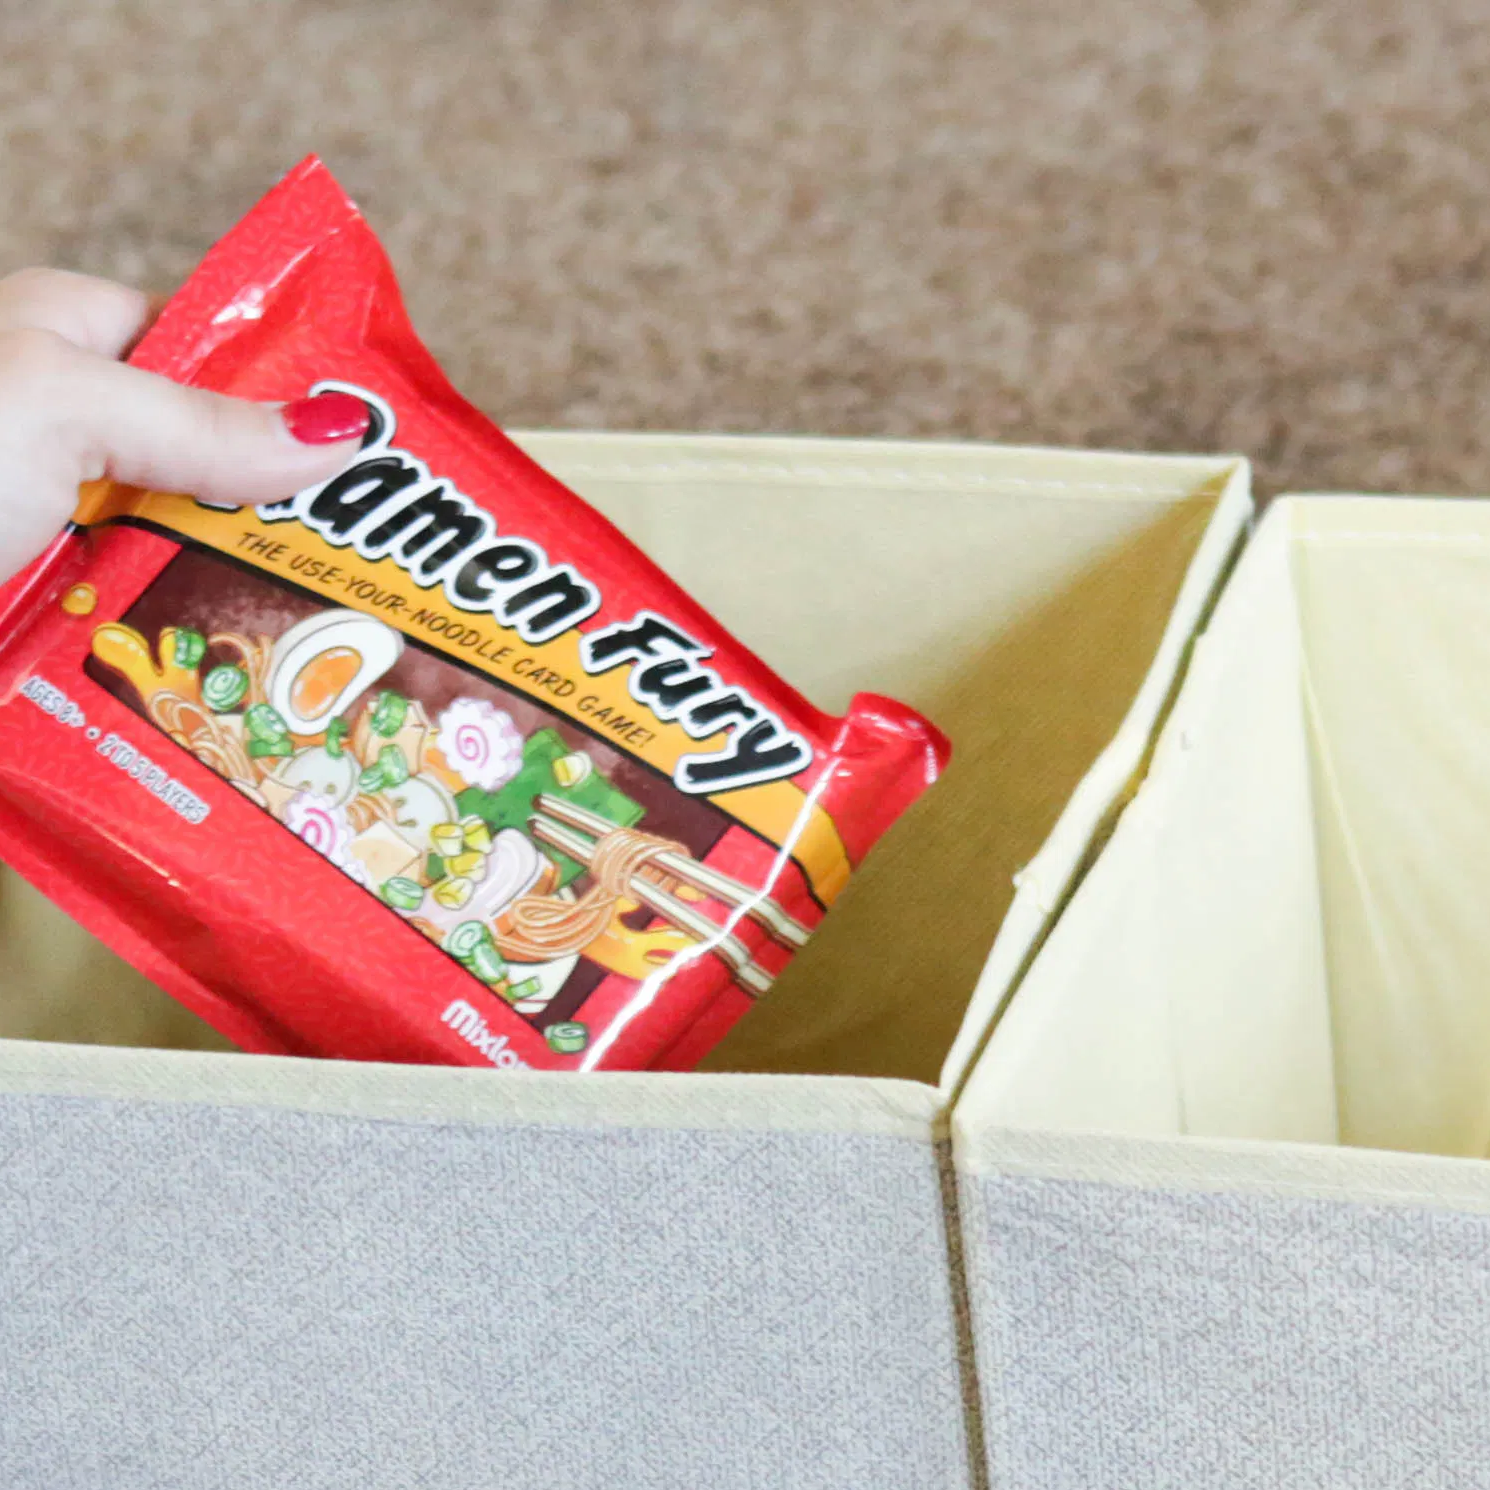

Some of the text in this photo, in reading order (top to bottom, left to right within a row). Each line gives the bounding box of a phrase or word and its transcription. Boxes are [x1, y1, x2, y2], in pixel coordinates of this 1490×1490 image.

[238, 532, 656, 748] THE USE-YOUR-NOODLE CARD GAME!
[582, 610, 812, 795] Fury
[20, 676, 66, 714] AGES
[98, 734, 120, 756] 2
[111, 740, 139, 769] TO
[128, 757, 152, 778] 5
[141, 766, 210, 823] PLAYERS
[441, 999, 534, 1070] mixlo
